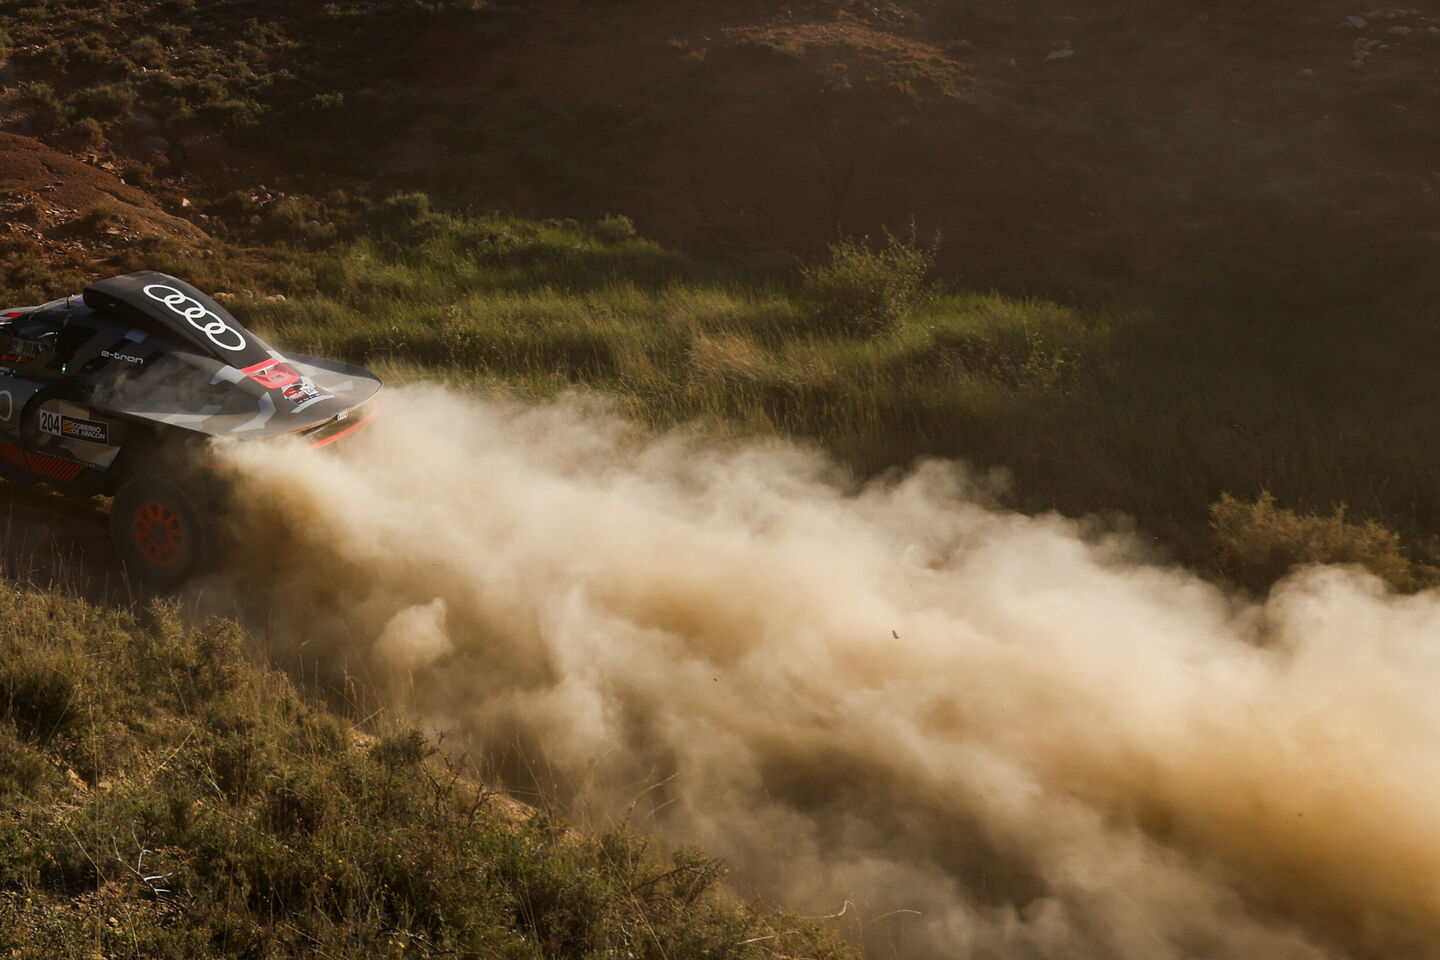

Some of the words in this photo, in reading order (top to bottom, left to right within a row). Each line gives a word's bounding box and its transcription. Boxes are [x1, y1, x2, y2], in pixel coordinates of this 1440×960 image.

[101, 350, 143, 365] e-tron
[41, 412, 59, 433] 204
[73, 422, 101, 433] GOBIERNO
